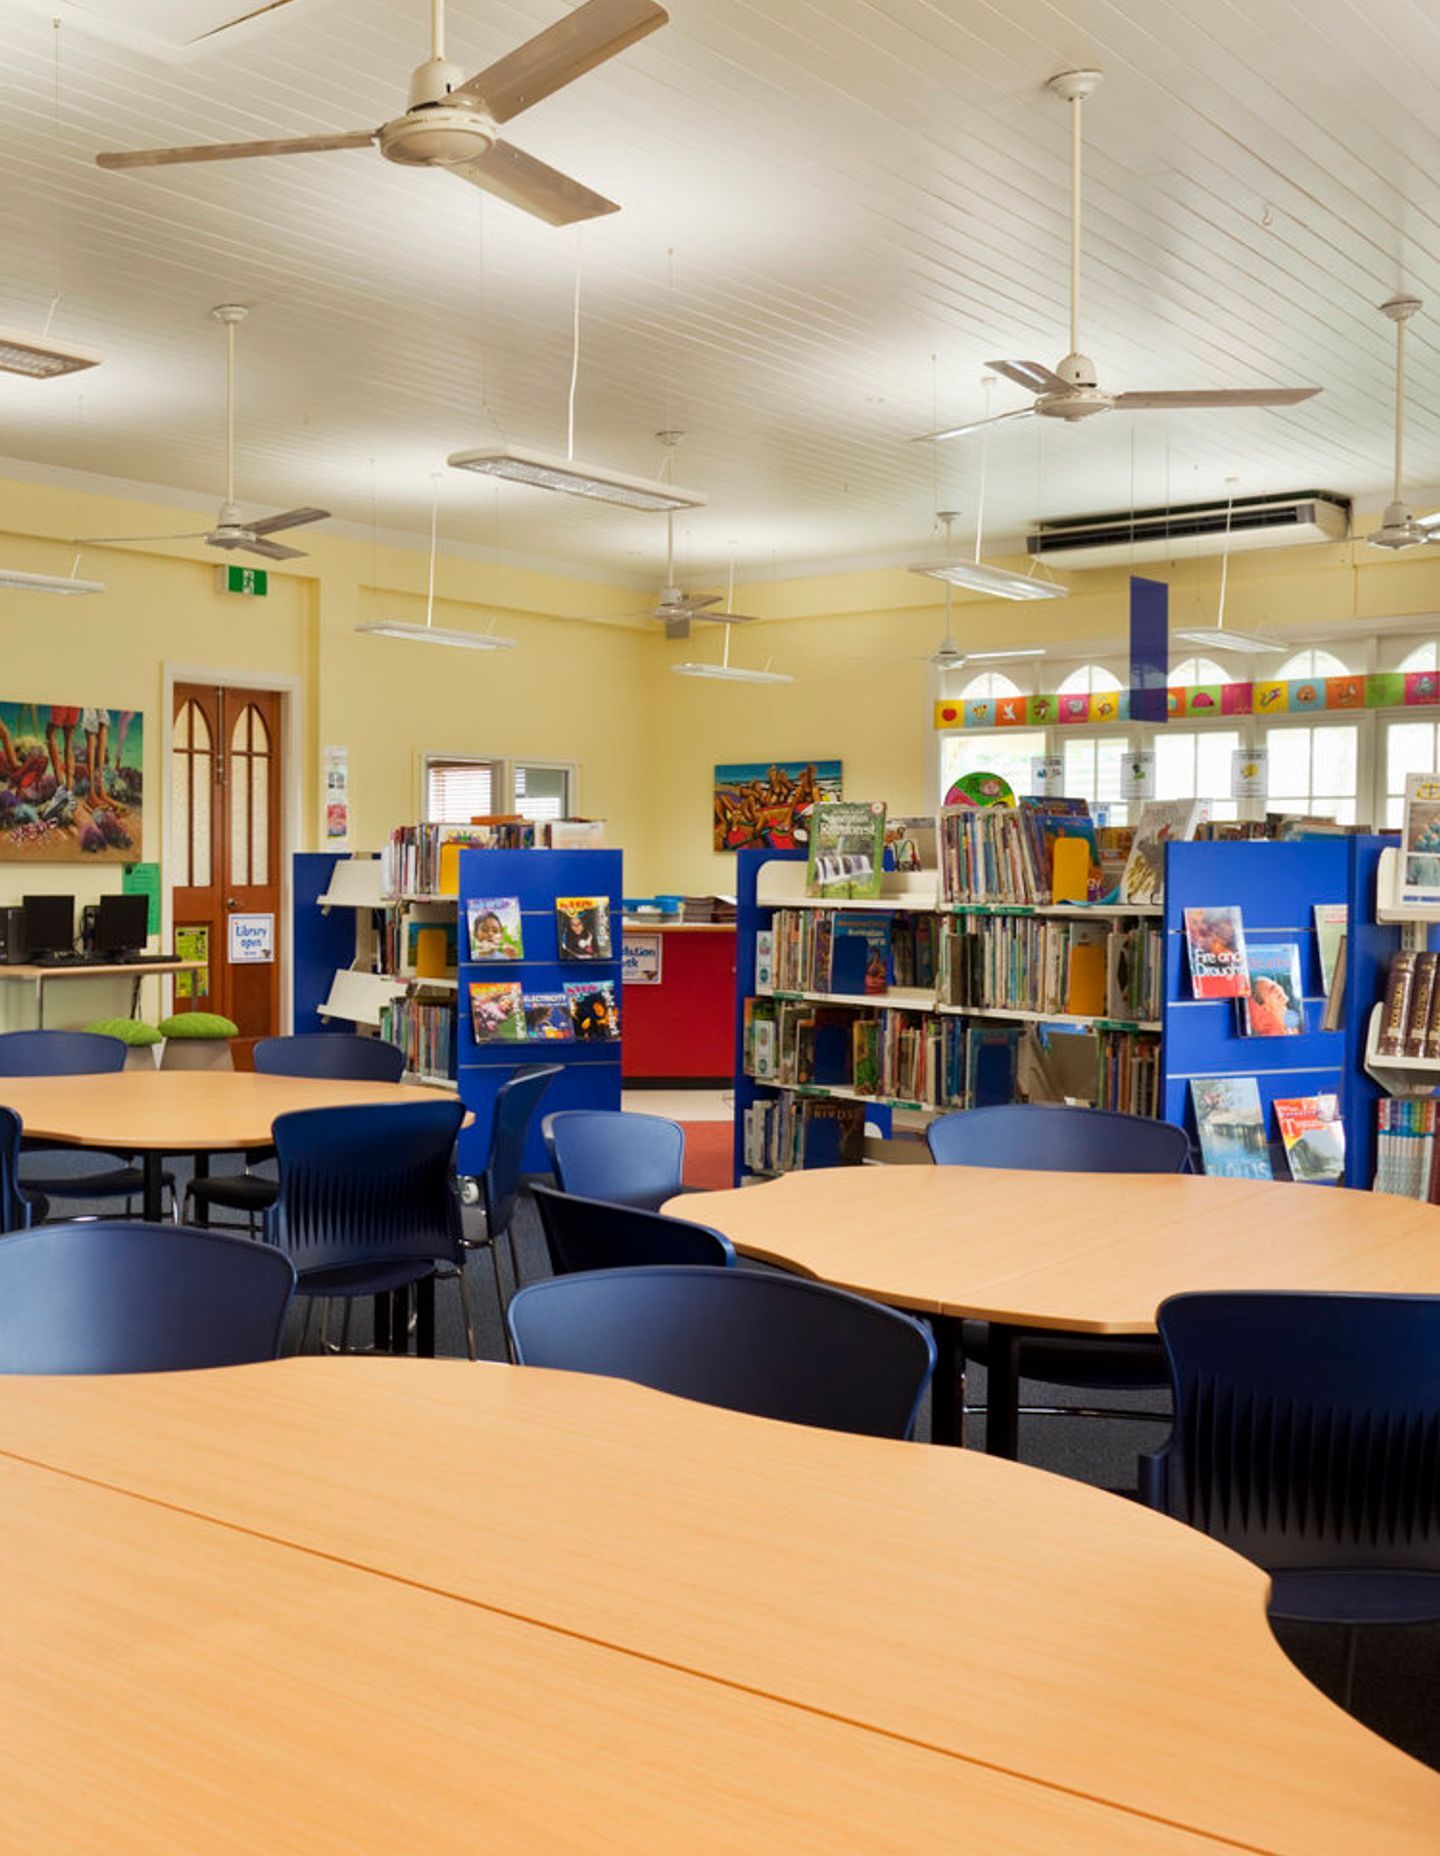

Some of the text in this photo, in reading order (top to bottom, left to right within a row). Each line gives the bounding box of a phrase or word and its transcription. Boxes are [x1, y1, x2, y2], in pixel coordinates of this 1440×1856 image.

[236, 924, 267, 938] Library
[240, 939, 262, 950] open
[1196, 949, 1216, 963] Fire
[1217, 951, 1243, 963] and
